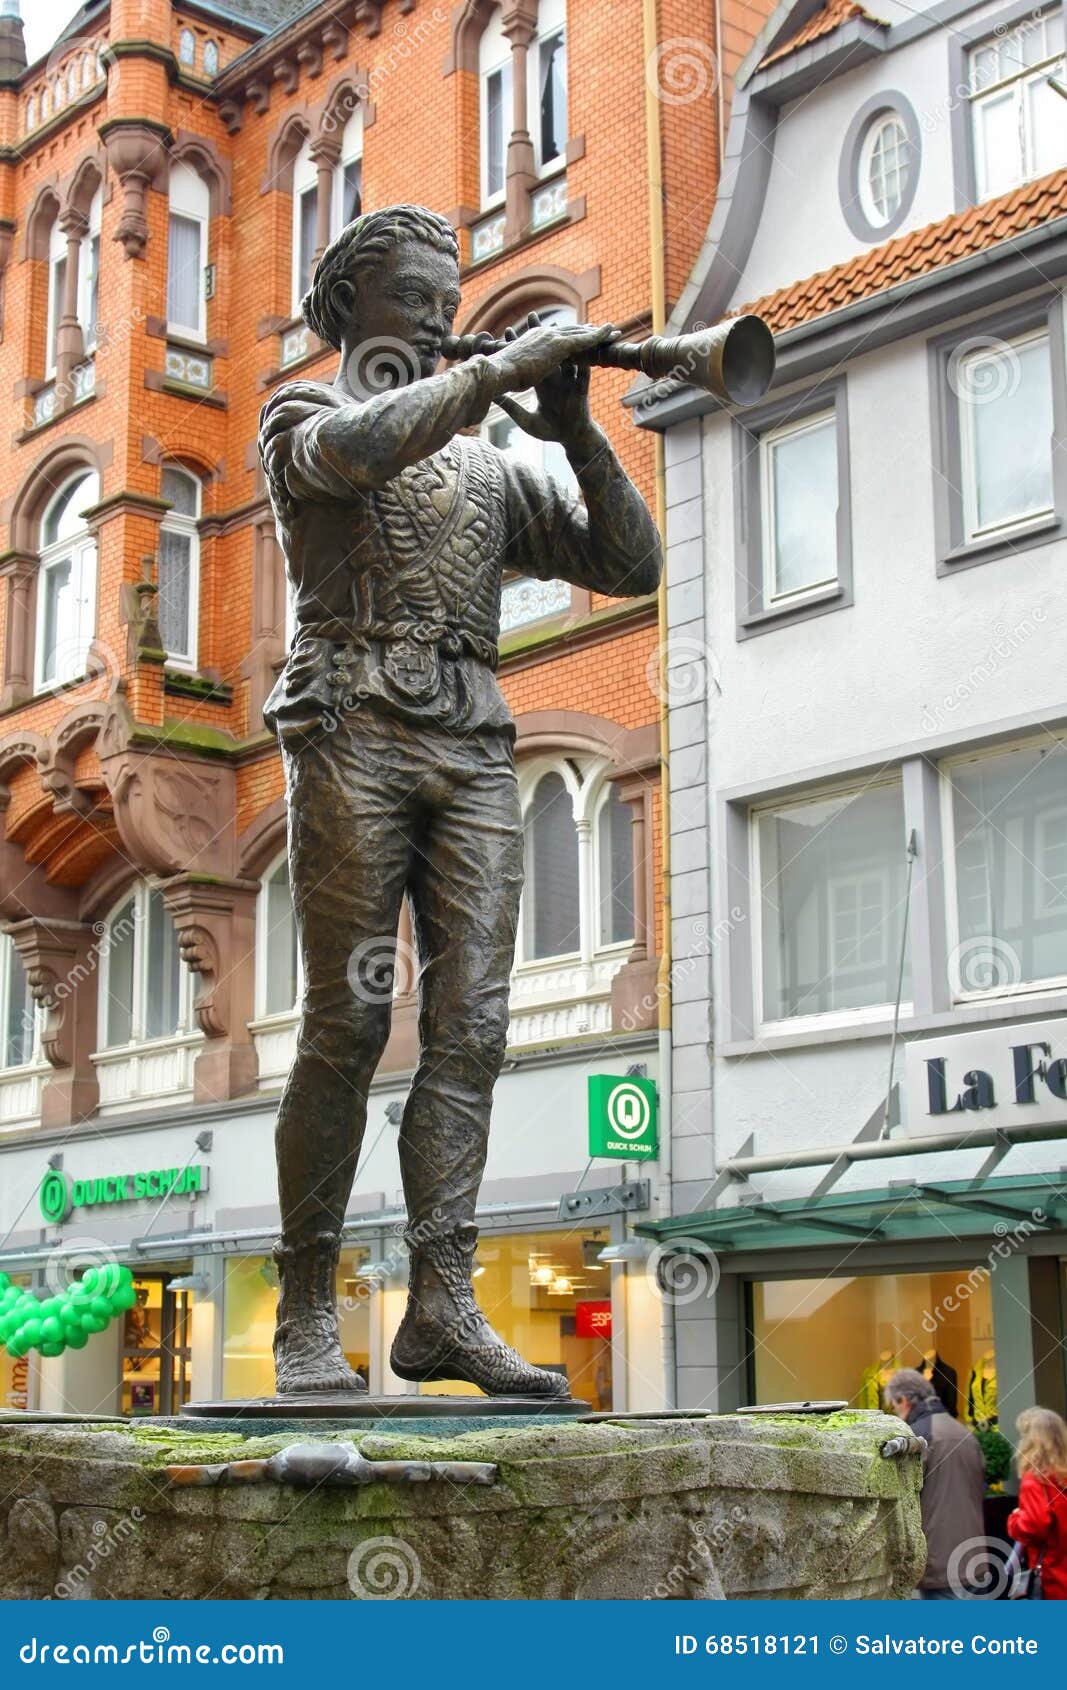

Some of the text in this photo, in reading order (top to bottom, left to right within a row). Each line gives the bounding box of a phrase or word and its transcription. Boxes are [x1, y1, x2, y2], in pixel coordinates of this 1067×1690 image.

[923, 1057, 998, 1115] La
[607, 1141, 629, 1151] QUICK
[72, 1174, 128, 1207] QUICK
[133, 1165, 201, 1199] SCHUH
